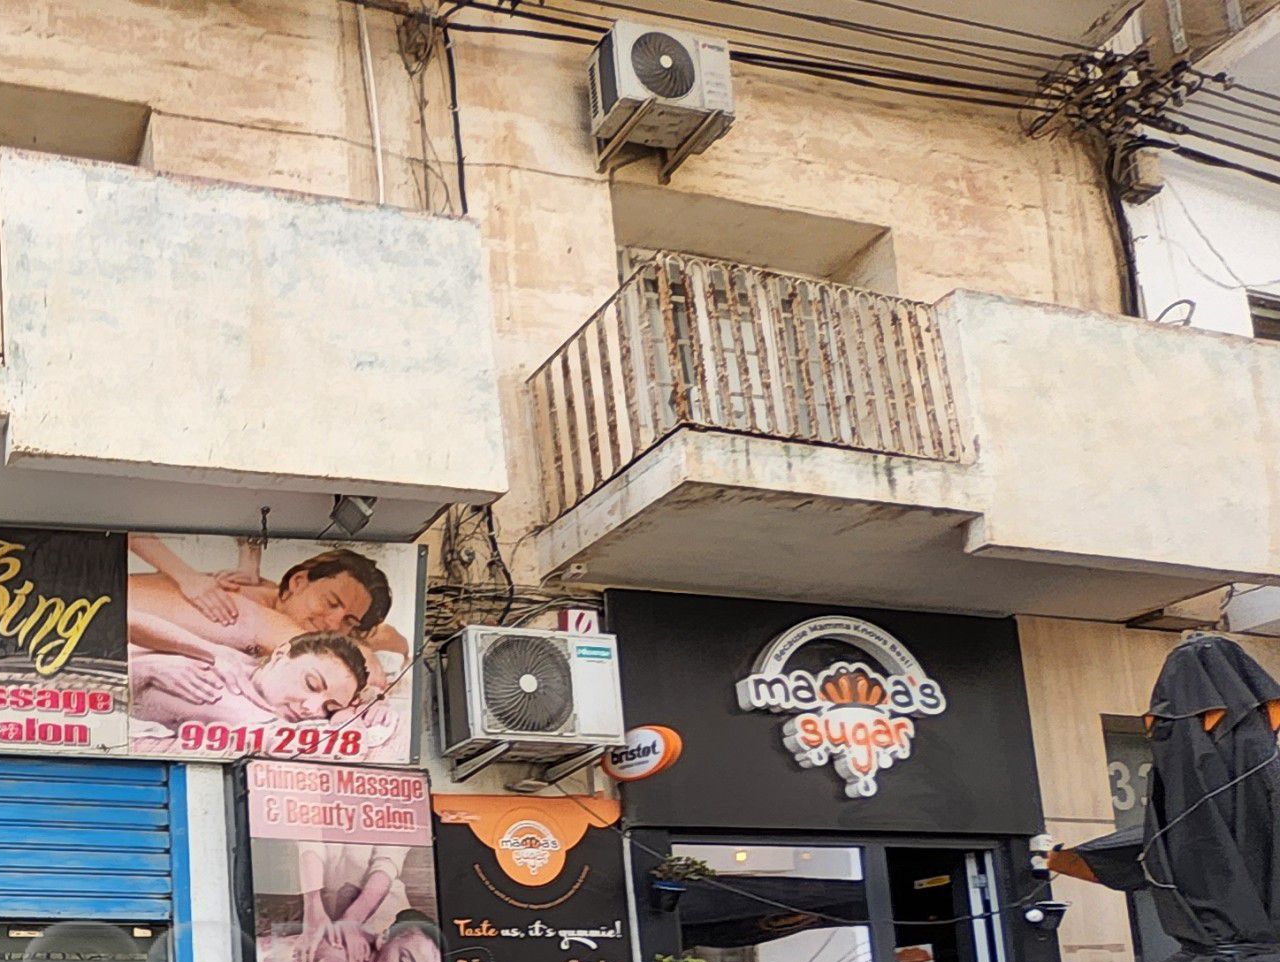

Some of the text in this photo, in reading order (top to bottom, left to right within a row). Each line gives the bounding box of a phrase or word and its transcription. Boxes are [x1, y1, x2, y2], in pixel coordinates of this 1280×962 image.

[809, 622, 851, 632] Mamma
[852, 623, 889, 647] Knows
[179, 722, 363, 757] 9911 2978
[799, 717, 909, 776] sugar
[254, 763, 424, 800] Chinese Massage
[286, 799, 356, 831] Beauty
[362, 803, 415, 830] Salon
[453, 919, 499, 938] Taste
[528, 920, 556, 938] it's
